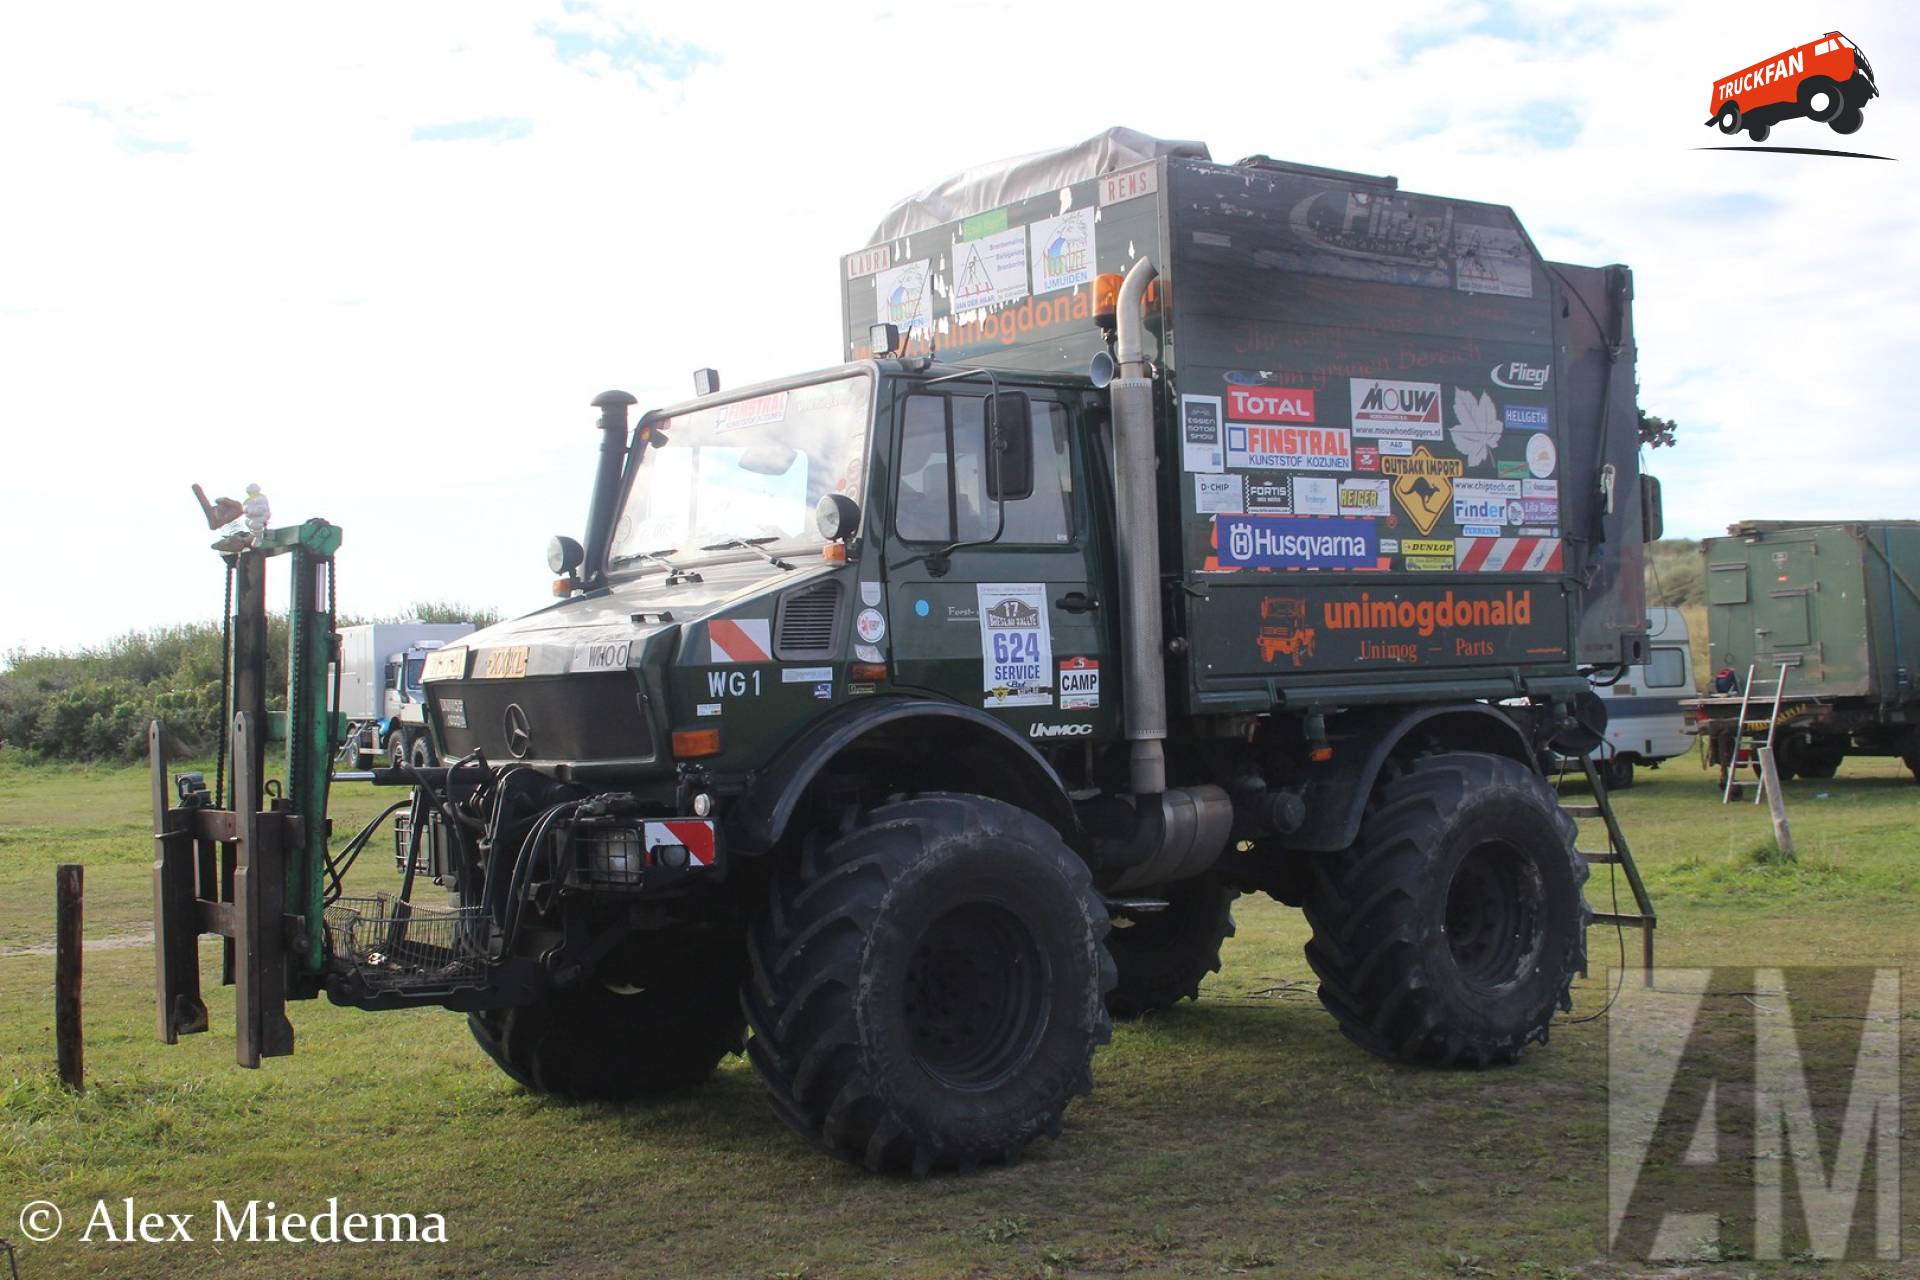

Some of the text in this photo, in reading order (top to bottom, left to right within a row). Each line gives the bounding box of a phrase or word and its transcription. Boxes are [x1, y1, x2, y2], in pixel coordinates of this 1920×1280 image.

[850, 249, 888, 276] LAURA
[1509, 362, 1550, 386] Fliegl
[1231, 391, 1310, 417] TOTAL
[1360, 385, 1436, 412] MOUW
[1248, 428, 1348, 456] FINSTRAL
[1249, 455, 1349, 468] KUNSTSTOF KOZIJNEN
[1384, 460, 1461, 475] OUTBACK IMPORT
[1250, 487, 1287, 496] FORTIS
[1341, 488, 1377, 507] REIGER
[1456, 500, 1505, 518] Finder
[1254, 528, 1366, 561] Husqvarna
[1412, 543, 1453, 552] DUNLOP
[1003, 602, 1018, 617] 17
[1324, 591, 1530, 636] unimogdonald
[993, 633, 1040, 664] 624
[1361, 640, 1417, 662] Unimog
[1456, 638, 1495, 656] Parts
[994, 665, 1041, 680] SERVICE
[1062, 674, 1097, 691] CAMP
